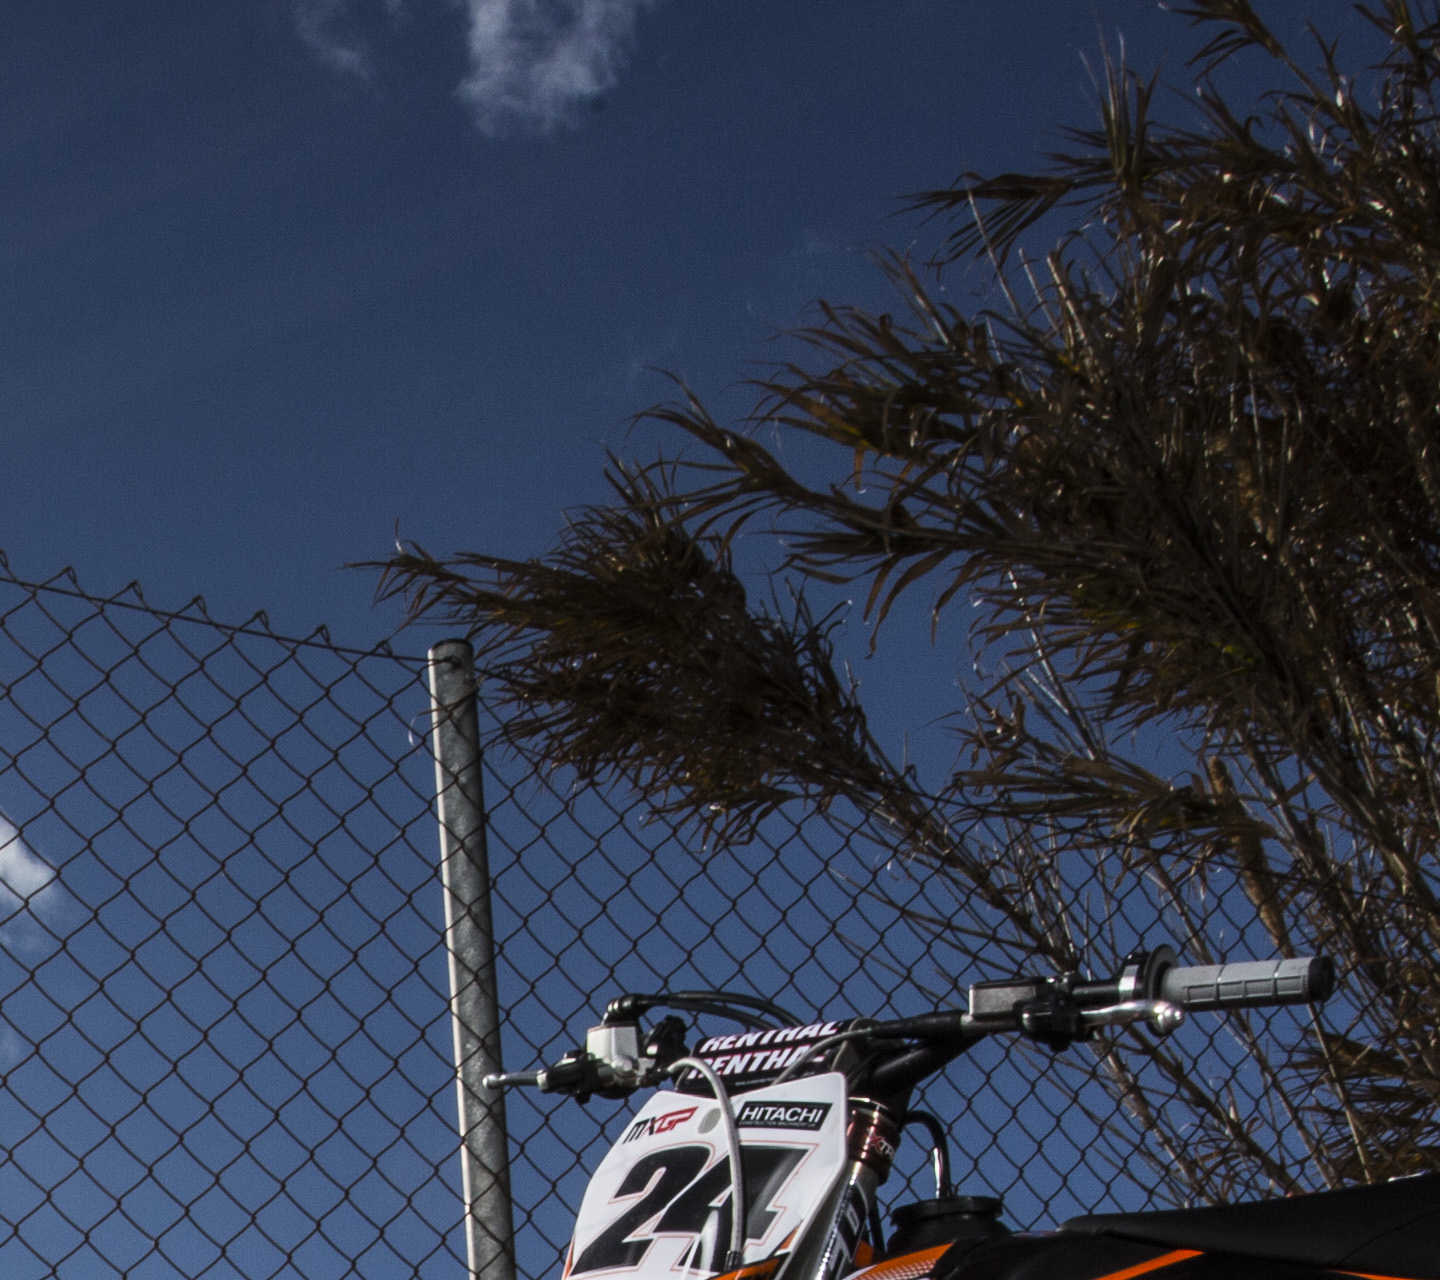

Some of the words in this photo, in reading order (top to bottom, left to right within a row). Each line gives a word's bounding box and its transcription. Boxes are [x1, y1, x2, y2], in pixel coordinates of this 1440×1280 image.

[698, 1020, 841, 1053] RENTHAL
[622, 1106, 699, 1145] MXGP
[740, 1106, 823, 1124] HITACHI
[567, 1143, 816, 1280] 24
